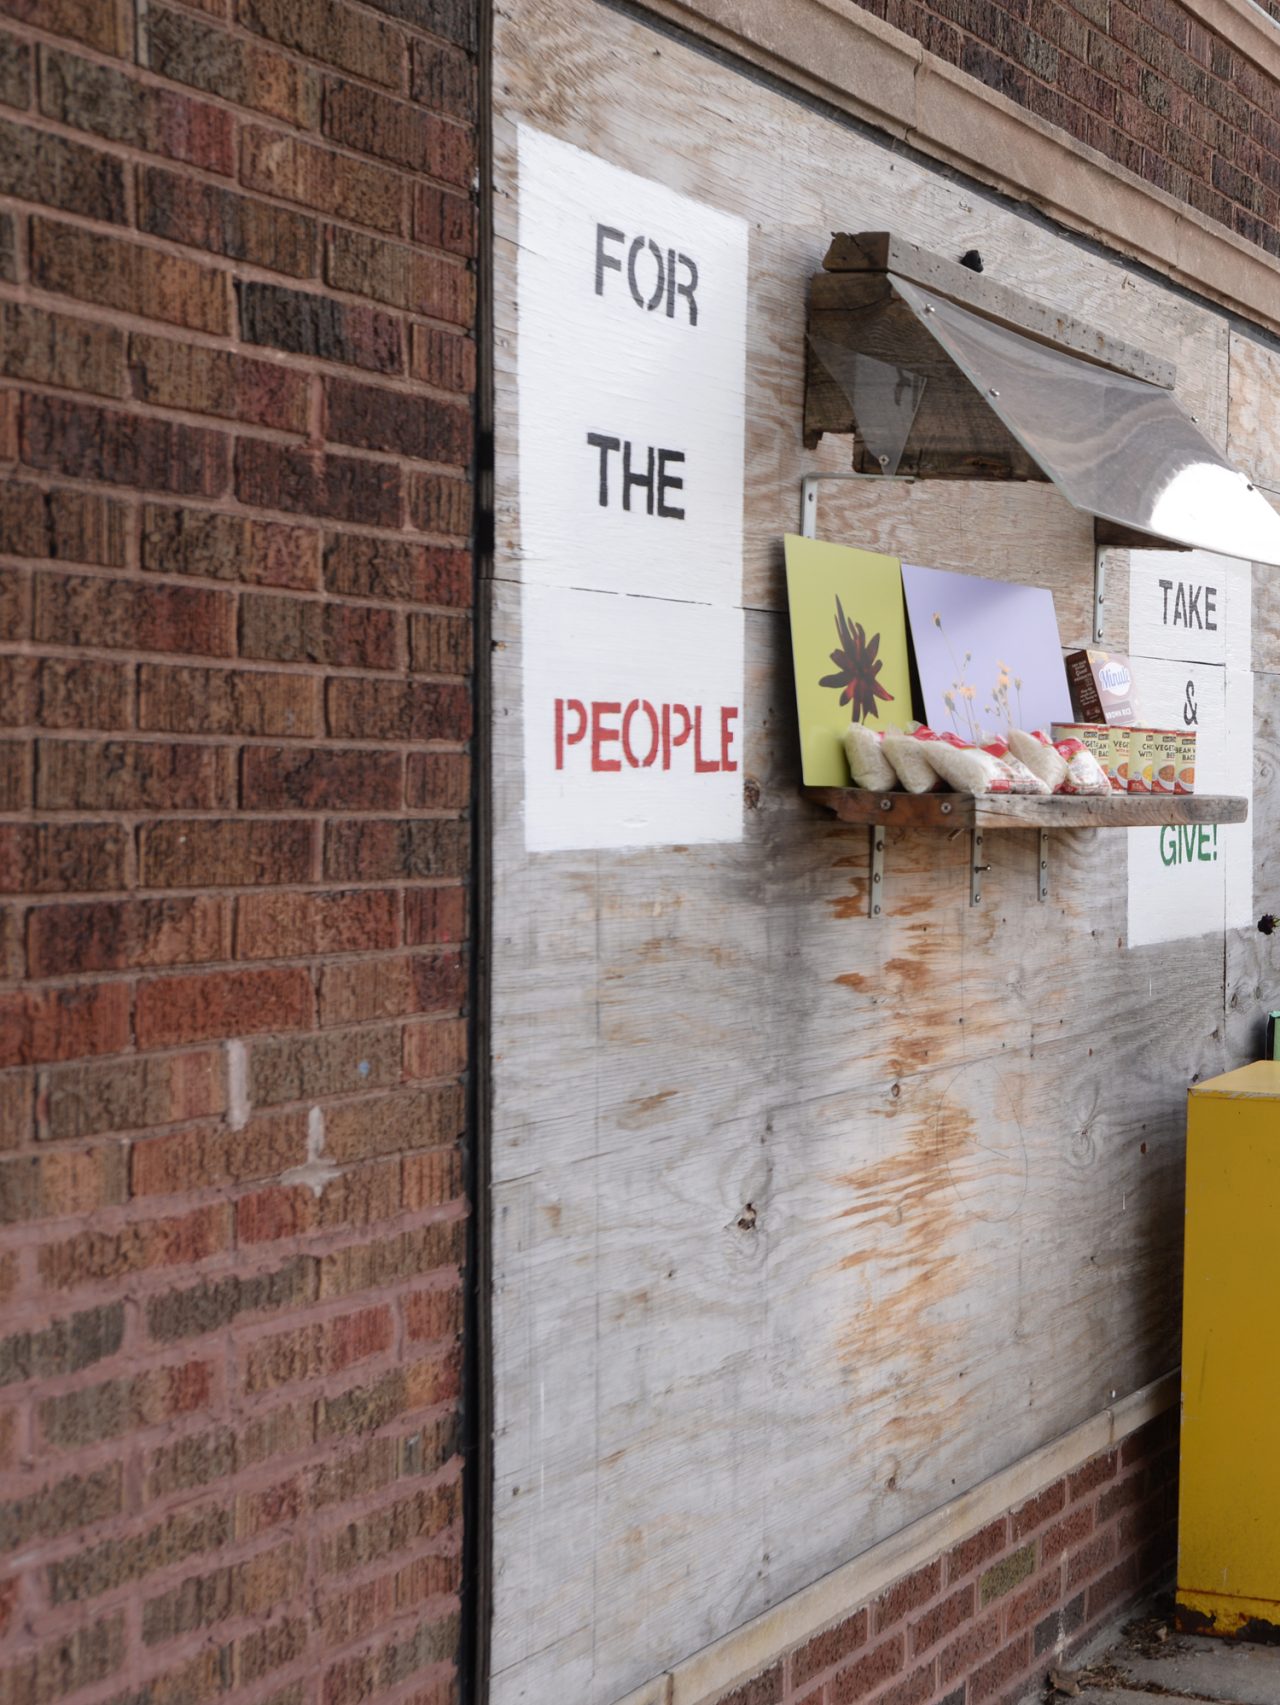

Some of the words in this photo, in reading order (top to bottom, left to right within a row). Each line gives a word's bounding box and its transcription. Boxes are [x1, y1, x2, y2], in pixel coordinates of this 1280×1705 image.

[593, 222, 699, 327] FOR
[586, 433, 686, 521] THE
[1158, 579, 1218, 631] TAKE
[1183, 680, 1198, 725] &
[554, 699, 739, 774] PEOPLE
[1159, 823, 1218, 867] GIVE!
